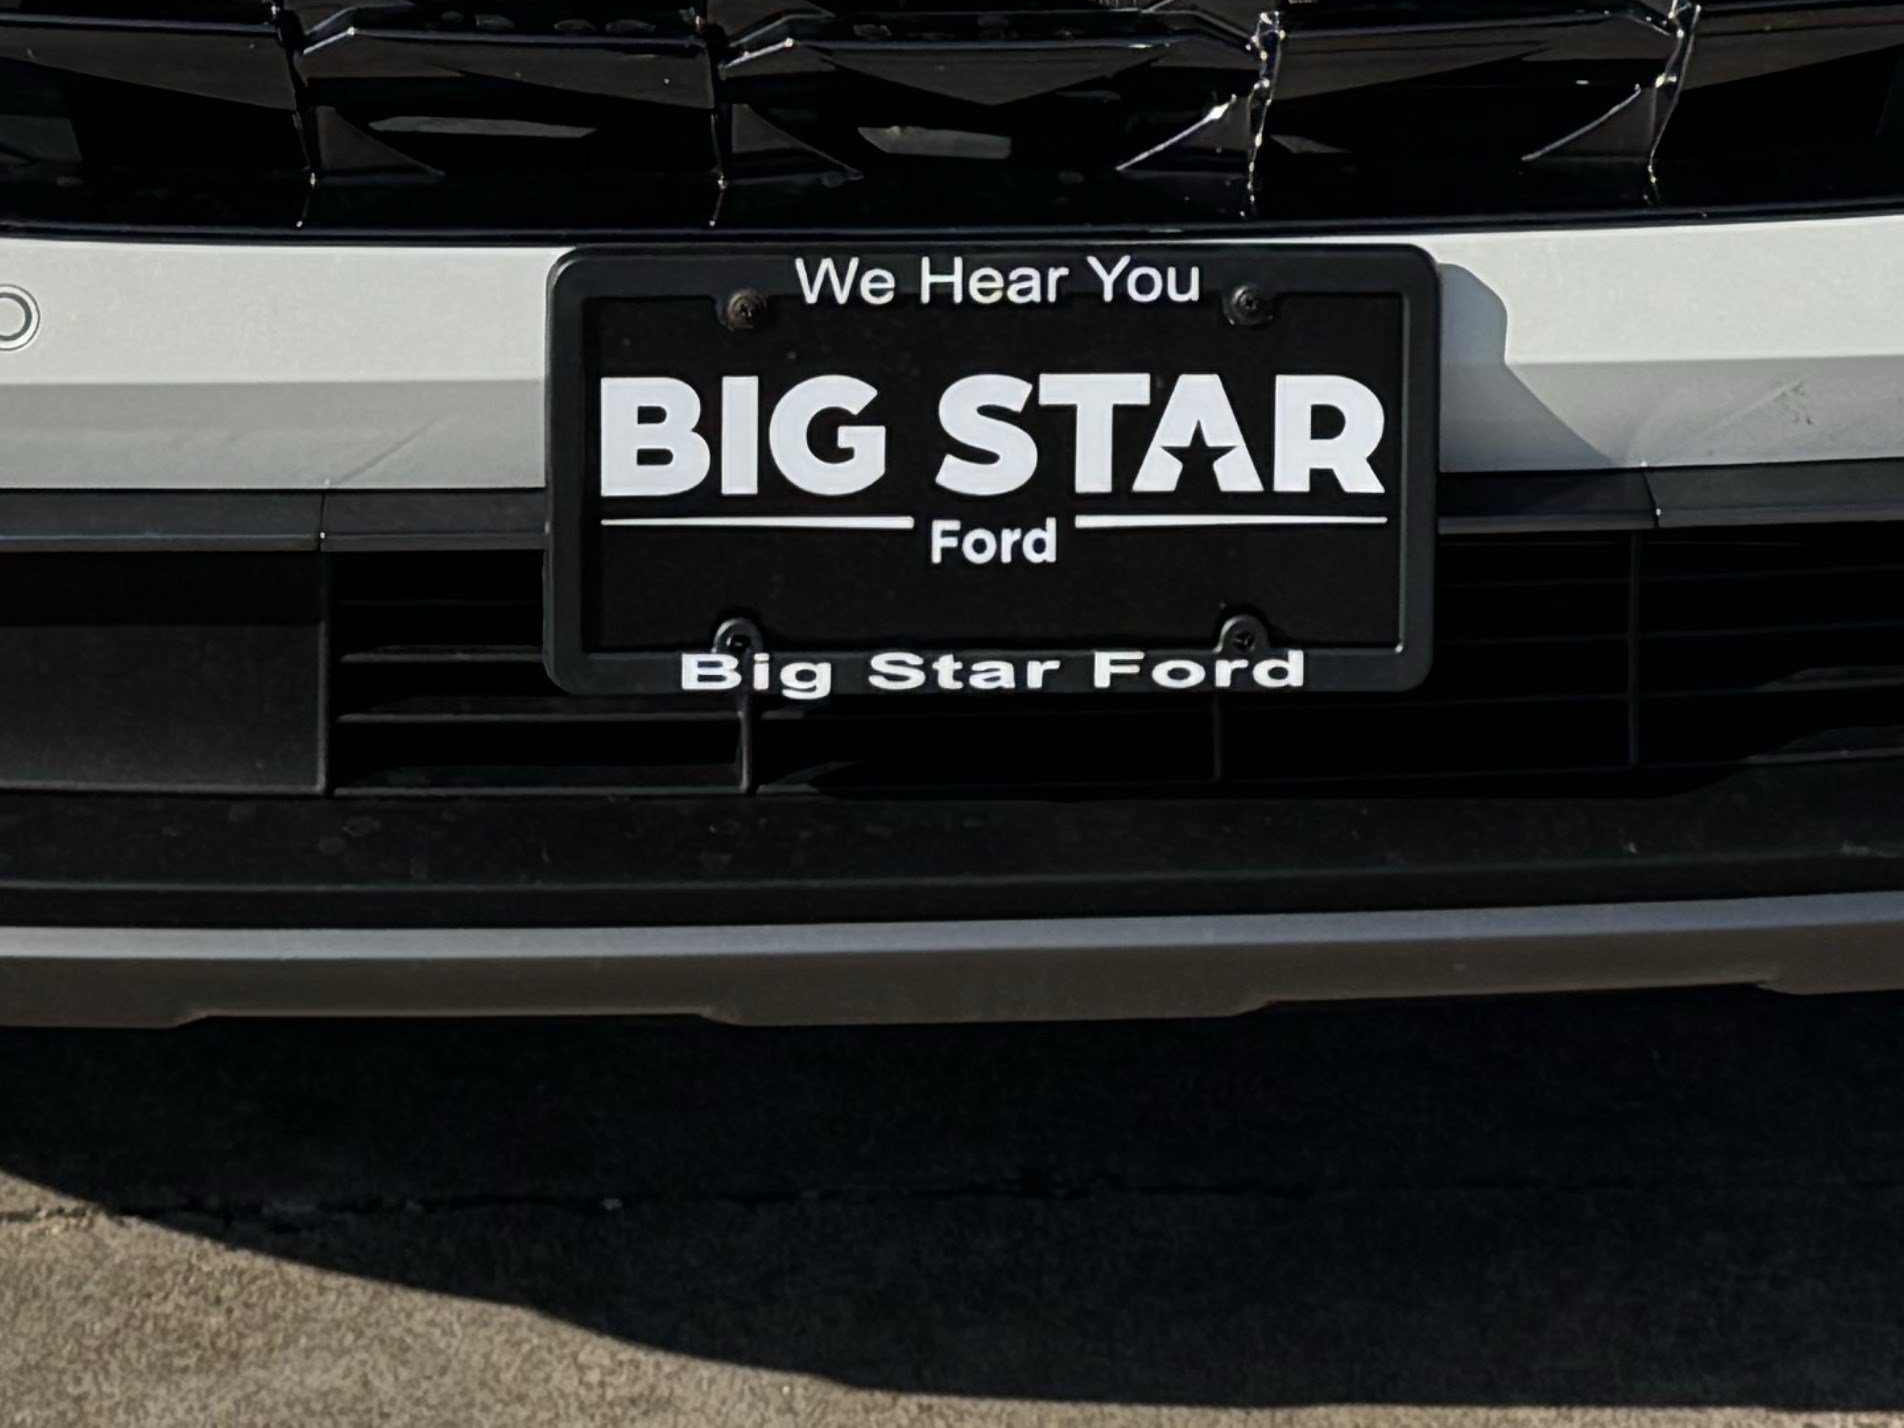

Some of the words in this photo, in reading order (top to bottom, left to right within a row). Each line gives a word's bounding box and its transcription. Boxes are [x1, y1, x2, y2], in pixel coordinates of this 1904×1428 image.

[794, 255, 897, 306] We
[920, 255, 1071, 305] Hear
[1086, 253, 1201, 304] You
[600, 373, 888, 497] BIG
[934, 372, 1386, 496] STAR
[930, 516, 1058, 565] Ford
[680, 647, 833, 700] Big
[867, 651, 1062, 691] Star
[1092, 648, 1305, 690] Ford
